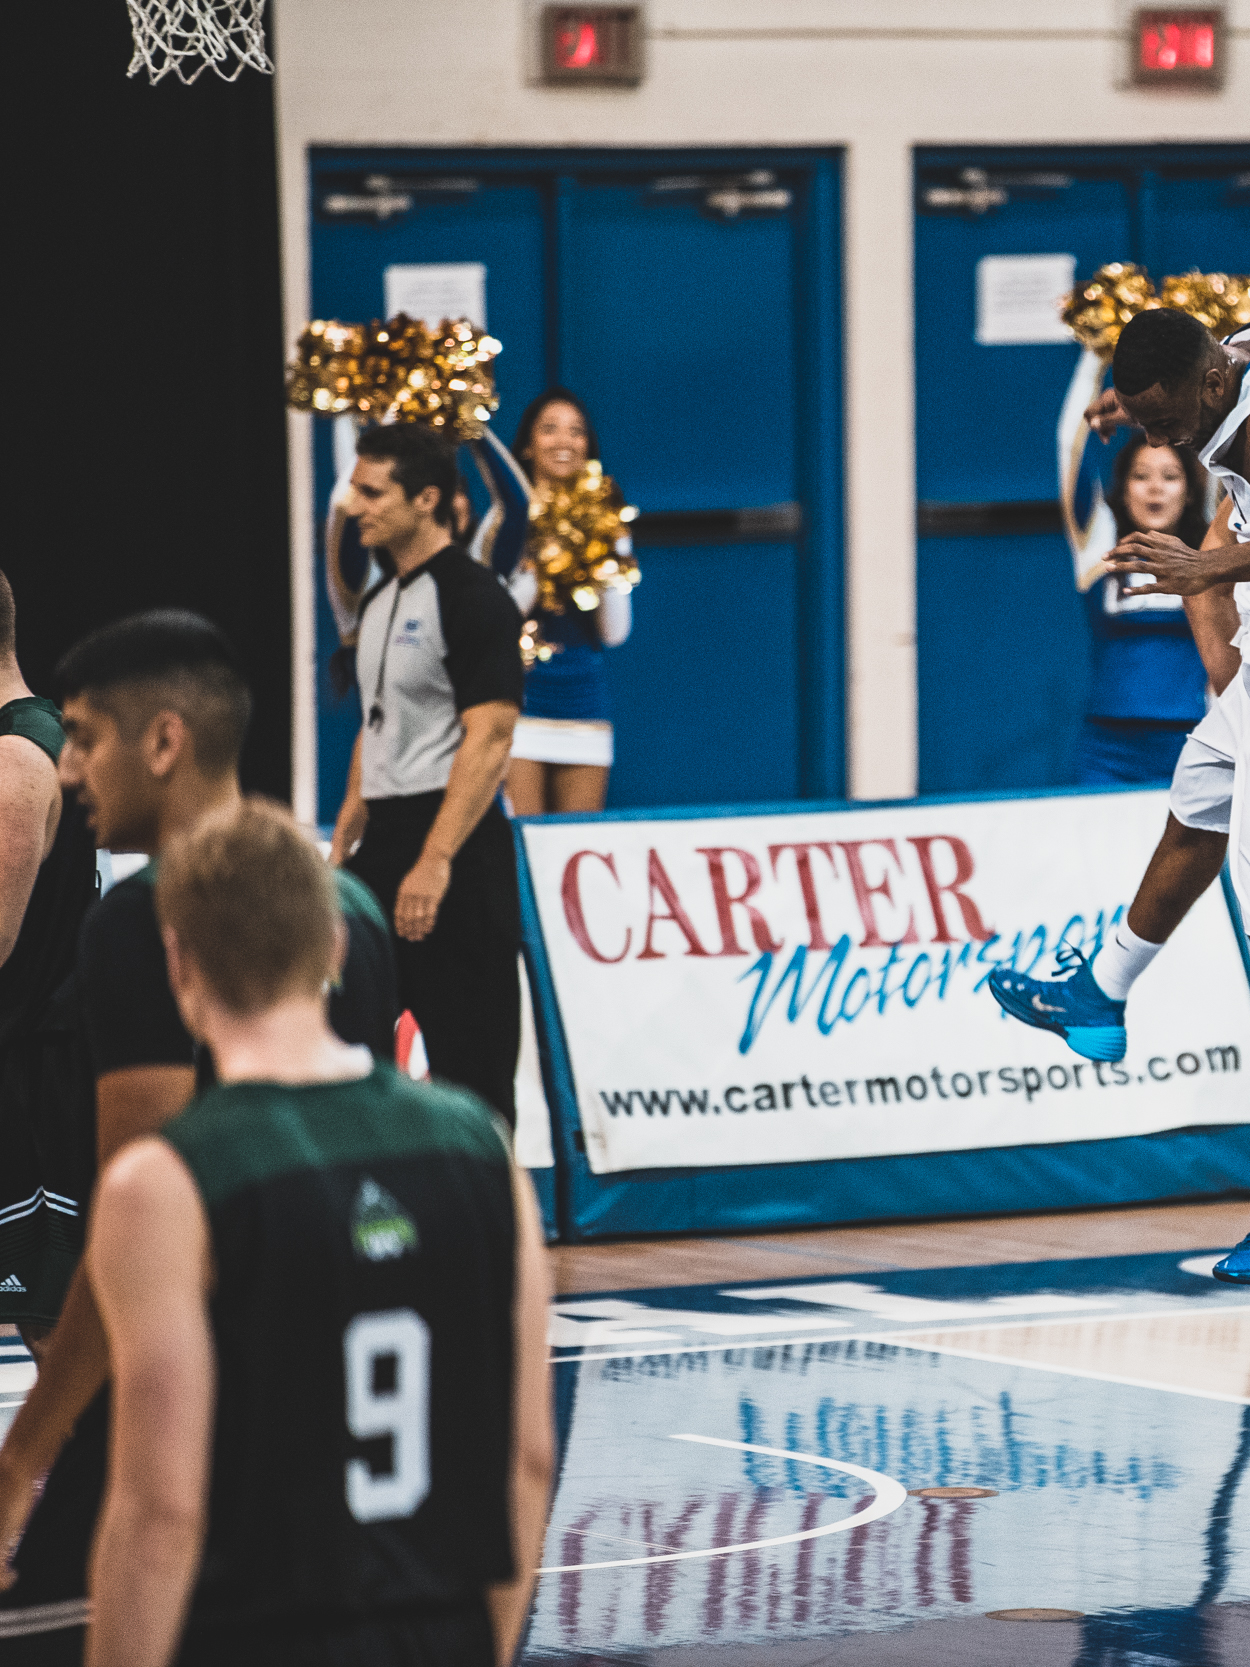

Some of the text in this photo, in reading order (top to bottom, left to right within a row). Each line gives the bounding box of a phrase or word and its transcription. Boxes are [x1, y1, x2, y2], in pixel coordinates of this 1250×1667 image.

[561, 835, 996, 964] CARTER
[737, 903, 1127, 1054] Motorspor
[599, 1044, 1241, 1117] www.cartermotorsports.com
[343, 1305, 433, 1524] 9
